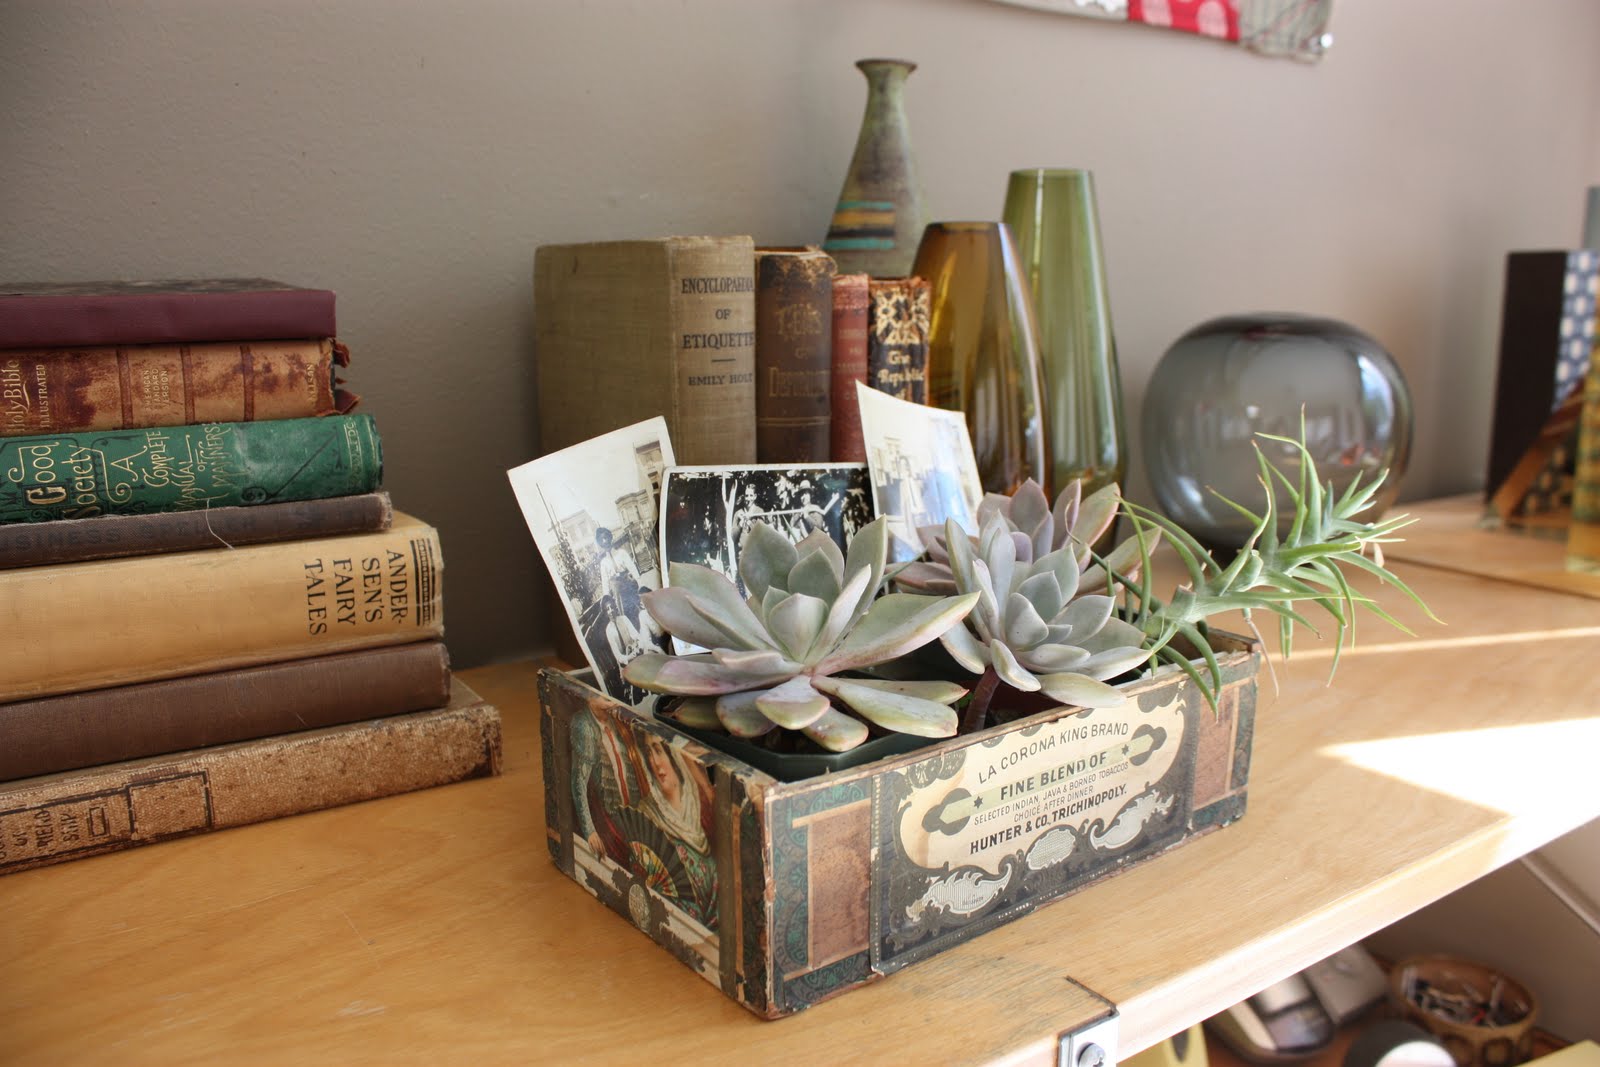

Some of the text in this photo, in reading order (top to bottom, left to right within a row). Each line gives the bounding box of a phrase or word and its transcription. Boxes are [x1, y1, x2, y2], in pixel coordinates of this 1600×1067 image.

[682, 331, 754, 350] ETIQUETTE
[715, 308, 732, 320] OF
[1, 359, 23, 399] Bible
[35, 364, 50, 428] ILLUSTRATED
[688, 373, 753, 386] EMILY HOLT
[110, 445, 148, 482] A
[304, 558, 328, 636] TALES
[333, 557, 356, 626] FAIRY
[362, 557, 385, 623] SEN'S
[386, 549, 408, 625] ANDER-
[978, 722, 1128, 785] LA CORONA KING BRAND
[1000, 751, 1107, 801] FINE BLEND OF
[969, 825, 1022, 855] HUNTER
[1025, 820, 1032, 833] &
[1052, 783, 1127, 823] TRICHINOPOLY.
[974, 804, 1010, 826] SELECTED
[1043, 786, 1061, 801] JAVA
[1063, 784, 1068, 793] &
[1069, 773, 1097, 791] BORNEO
[1098, 761, 1129, 779] TOBACCOS
[1014, 785, 1094, 823] CHOICE AFTER DINNER
